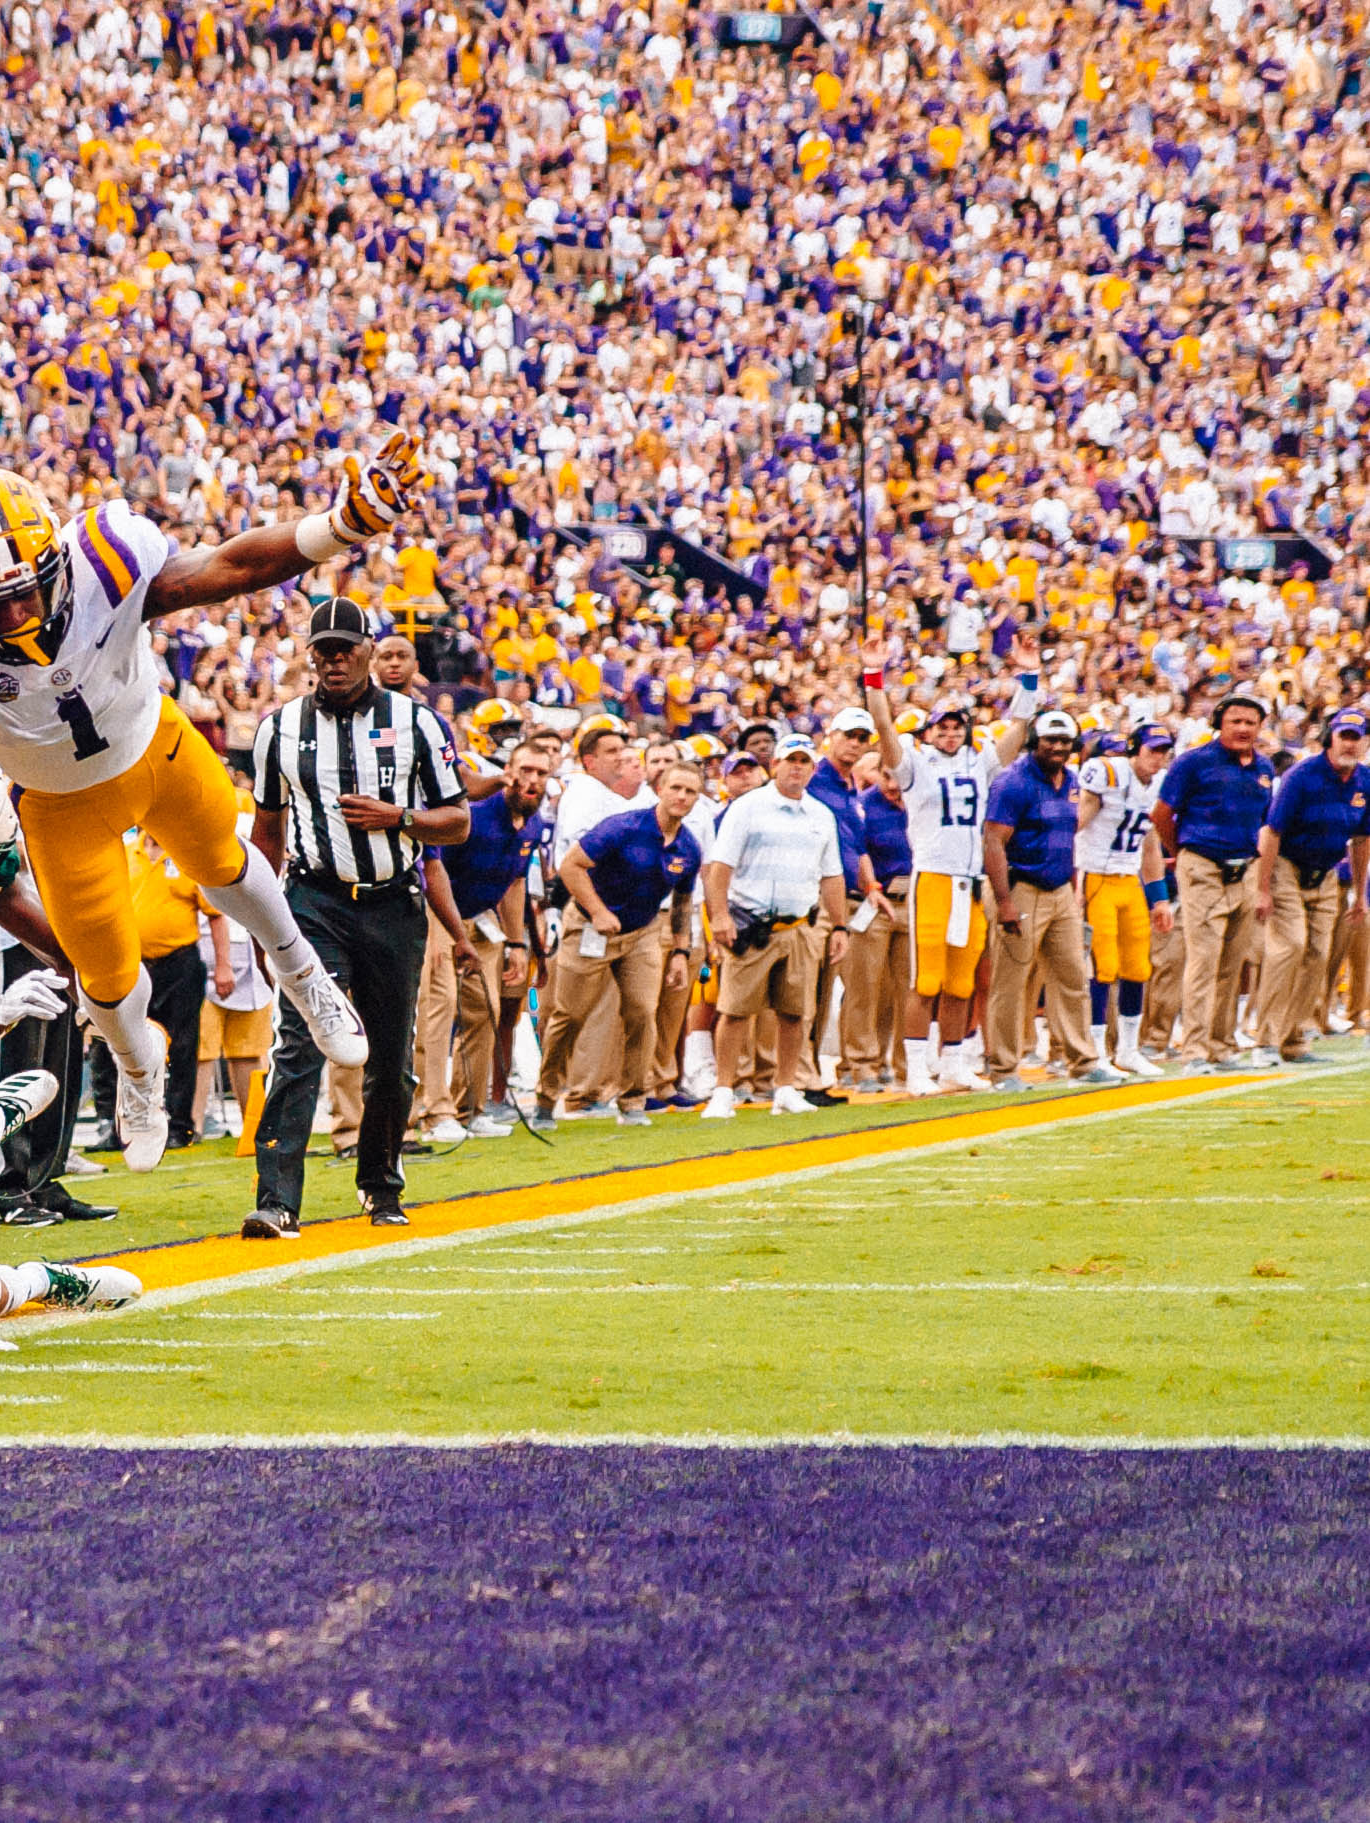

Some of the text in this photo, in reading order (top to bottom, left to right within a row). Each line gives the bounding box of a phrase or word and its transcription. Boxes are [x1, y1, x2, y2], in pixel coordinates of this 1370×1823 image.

[55, 685, 110, 762] 1
[379, 766, 395, 788] H
[938, 776, 979, 827] 13
[1110, 809, 1148, 854] 16
